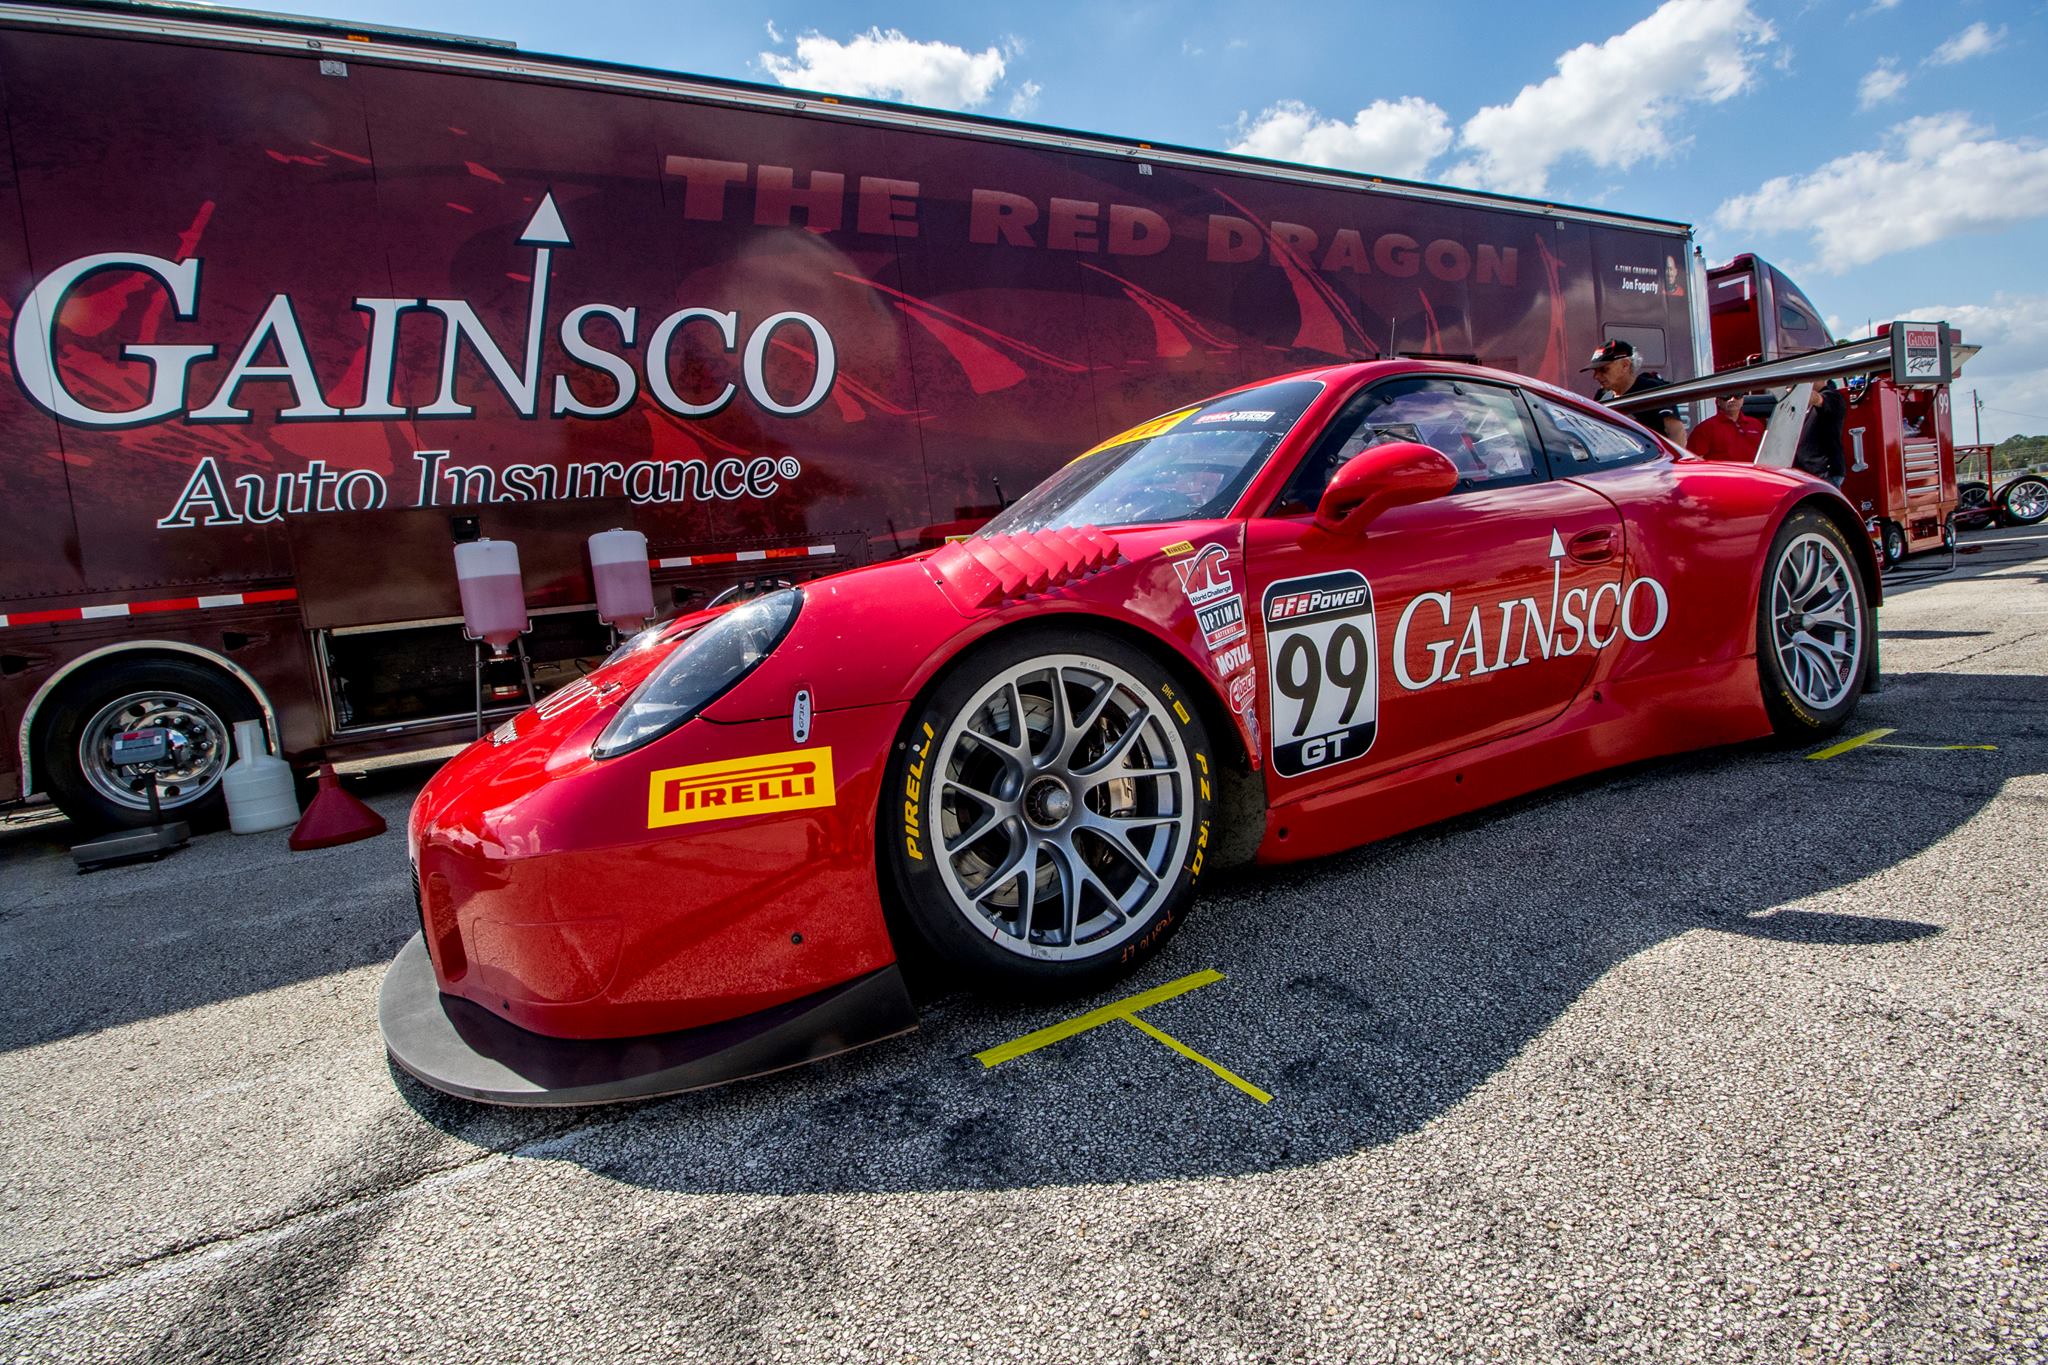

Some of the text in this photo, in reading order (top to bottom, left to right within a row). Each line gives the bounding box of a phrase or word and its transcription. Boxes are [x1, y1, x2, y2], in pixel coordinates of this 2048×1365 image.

[664, 154, 1520, 288] THE RED DRAGON
[11, 190, 838, 427] GAINSCO
[1622, 277, 1659, 295] Jon Fogarty
[1908, 331, 1937, 347] GAINSCO
[1938, 393, 1949, 415] 99
[156, 456, 387, 529] Auto
[1174, 548, 1231, 595] WC
[1190, 584, 1232, 604] World Challenge
[1201, 603, 1241, 632] OPTIMA
[1392, 526, 1670, 691] GAINSCO
[1215, 642, 1252, 677] MOTUL
[1275, 622, 1369, 737] 99
[1301, 730, 1350, 767] GT
[662, 760, 817, 814] PIRELLI
[904, 721, 937, 861] PIRELLI
